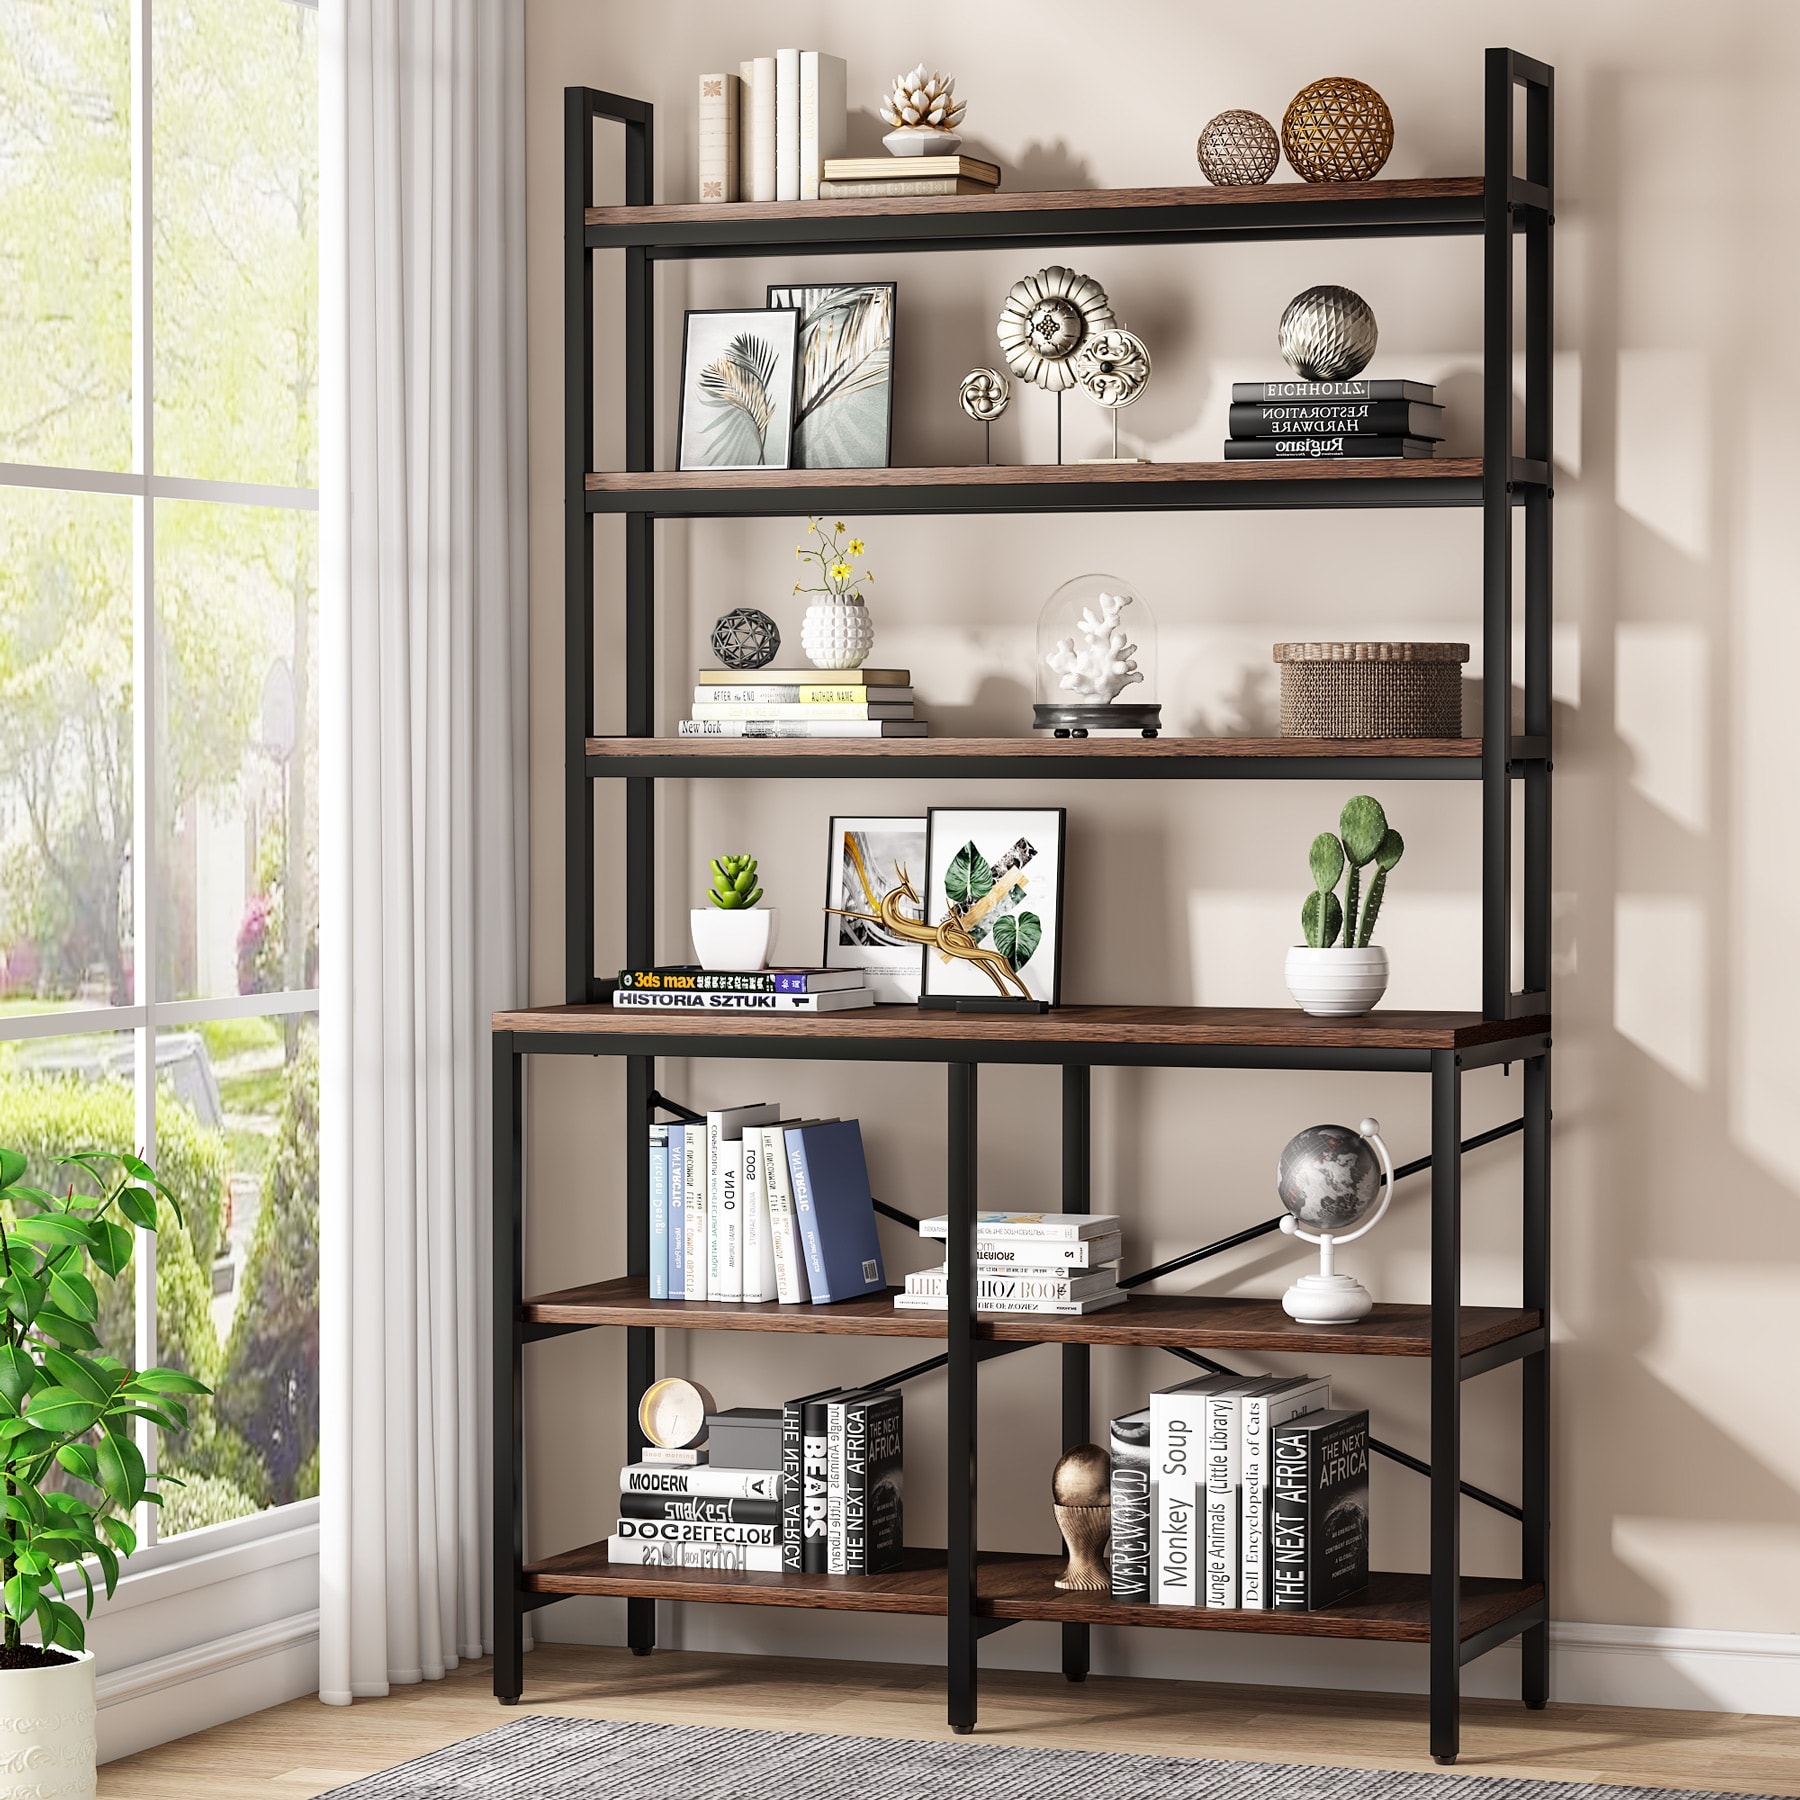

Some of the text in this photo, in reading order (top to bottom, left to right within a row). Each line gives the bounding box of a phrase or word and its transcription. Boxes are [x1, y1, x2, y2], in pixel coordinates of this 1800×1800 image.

[713, 690, 732, 702] AFTER
[743, 690, 755, 702] END
[811, 691, 834, 702] AUTHOR
[836, 691, 854, 702] NAME
[682, 720, 722, 735] New York
[634, 972, 696, 989] 3ds max
[619, 992, 776, 1008] HISTORIA SZTUKI
[869, 1415, 900, 1436] THE NEXT
[868, 1433, 901, 1464] AFRICA
[1321, 1443, 1340, 1463] THE
[1341, 1430, 1366, 1453] NEXT
[629, 1473, 688, 1492] MODERN
[1319, 1449, 1368, 1490] AFRICA
[751, 1479, 765, 1495] A
[803, 1435, 828, 1539] BEARS
[846, 1410, 866, 1571] THE NEXT AFRICA
[1245, 1402, 1262, 1602] Dell Encyclopedia of Cats
[664, 1496, 735, 1523] snakes!
[1162, 1419, 1194, 1587] Monkey Soup
[1208, 1399, 1234, 1607] Jungle Animals (Little Library)
[1112, 1469, 1151, 1596] WEREWORLD
[1275, 1433, 1308, 1606] THE NEXT AFRICA
